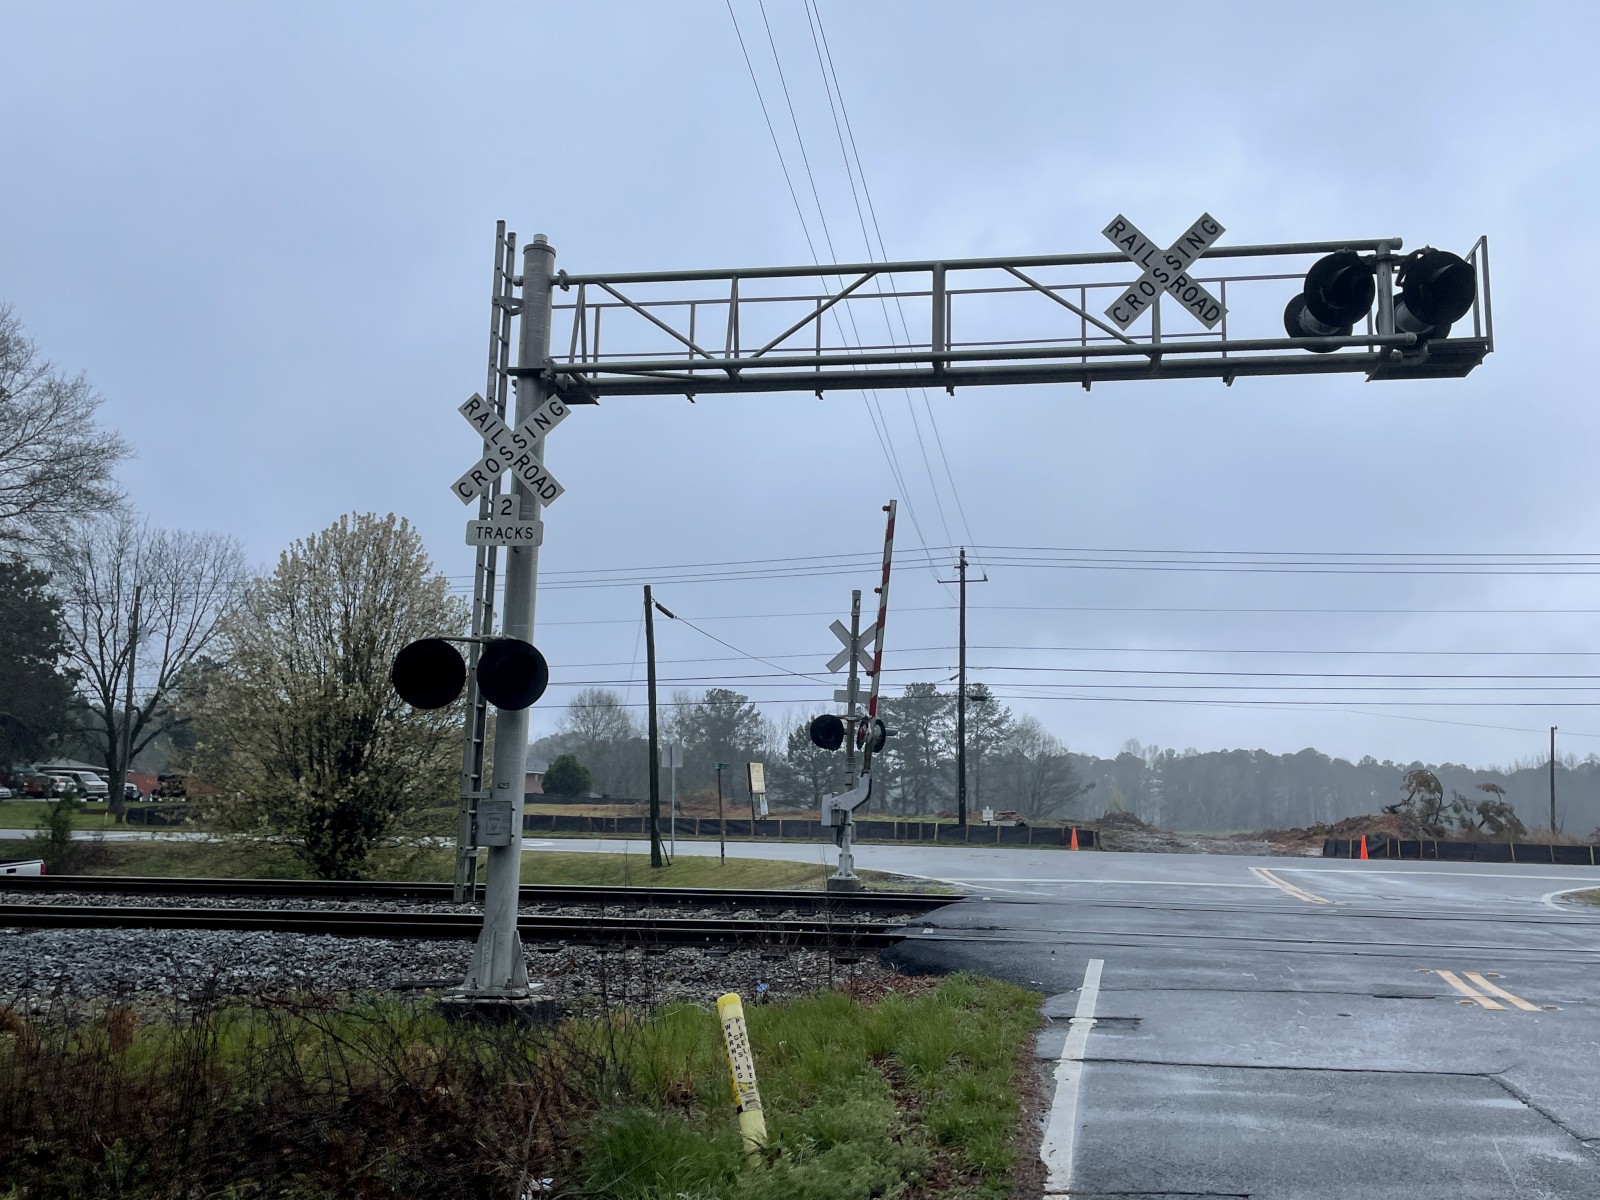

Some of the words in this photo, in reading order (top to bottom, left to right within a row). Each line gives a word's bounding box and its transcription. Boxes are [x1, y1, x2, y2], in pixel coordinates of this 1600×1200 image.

[1112, 219, 1218, 323] CROSSING
[458, 401, 564, 498] CROSSING
[476, 526, 534, 540] TRACKS
[500, 498, 513, 516] 2
[725, 1024, 743, 1079] WARNING
[733, 1034, 744, 1058] GAS
[735, 1018, 754, 1079] PIPELINE
